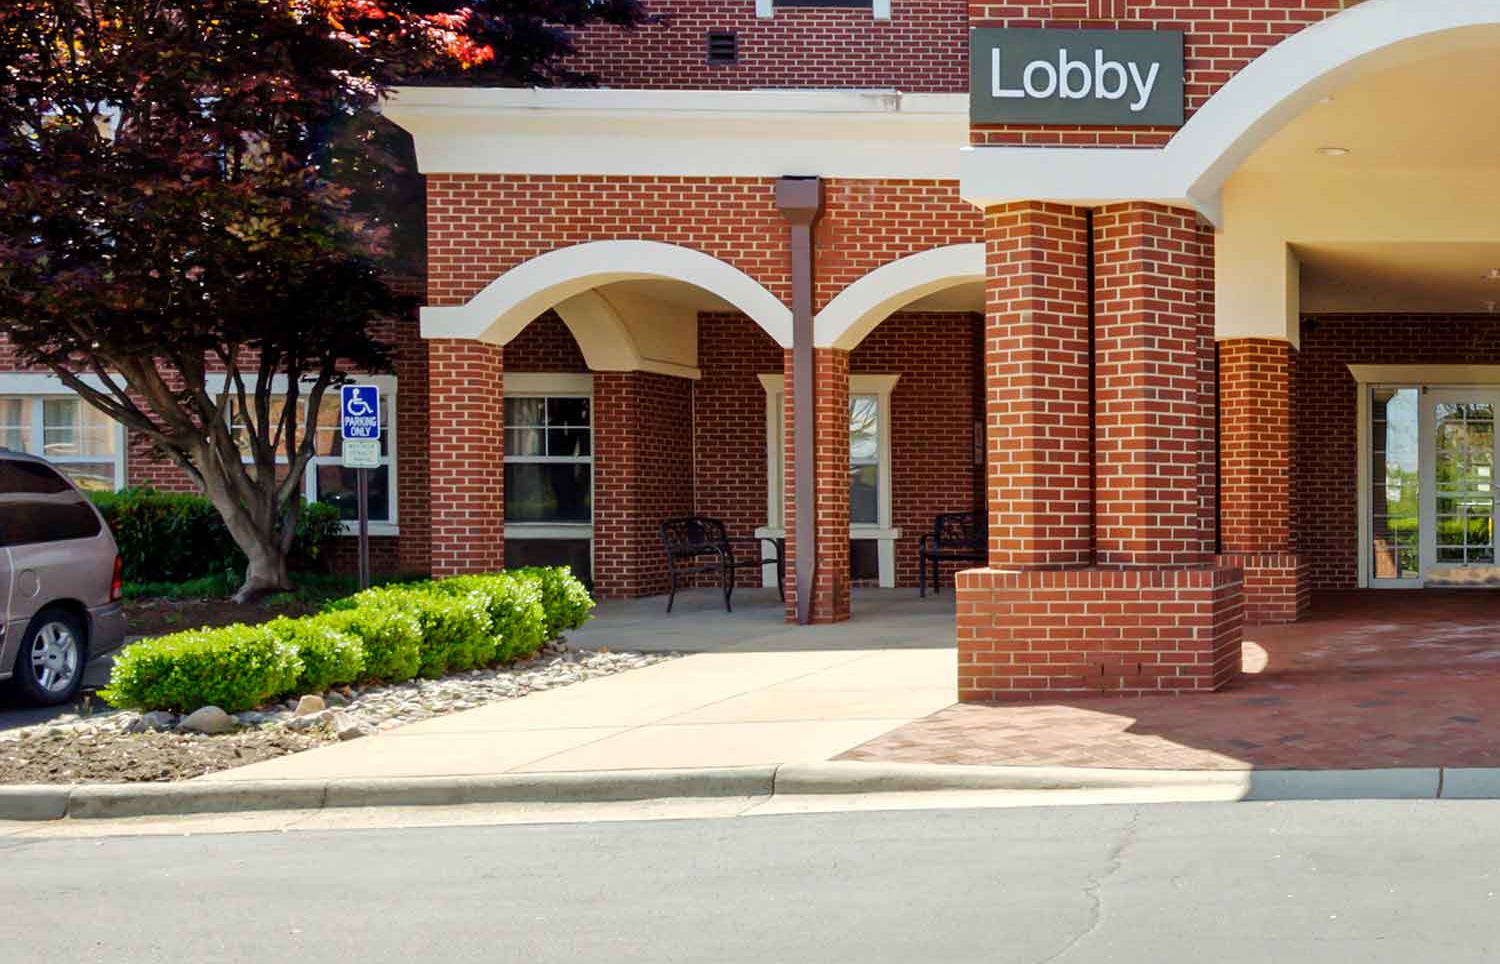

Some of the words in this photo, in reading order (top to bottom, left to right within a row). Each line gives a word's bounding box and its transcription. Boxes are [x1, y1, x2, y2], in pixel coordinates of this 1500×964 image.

[991, 47, 1160, 112] Lobby
[344, 416, 377, 427] PARKING
[350, 427, 371, 436] ONLY
